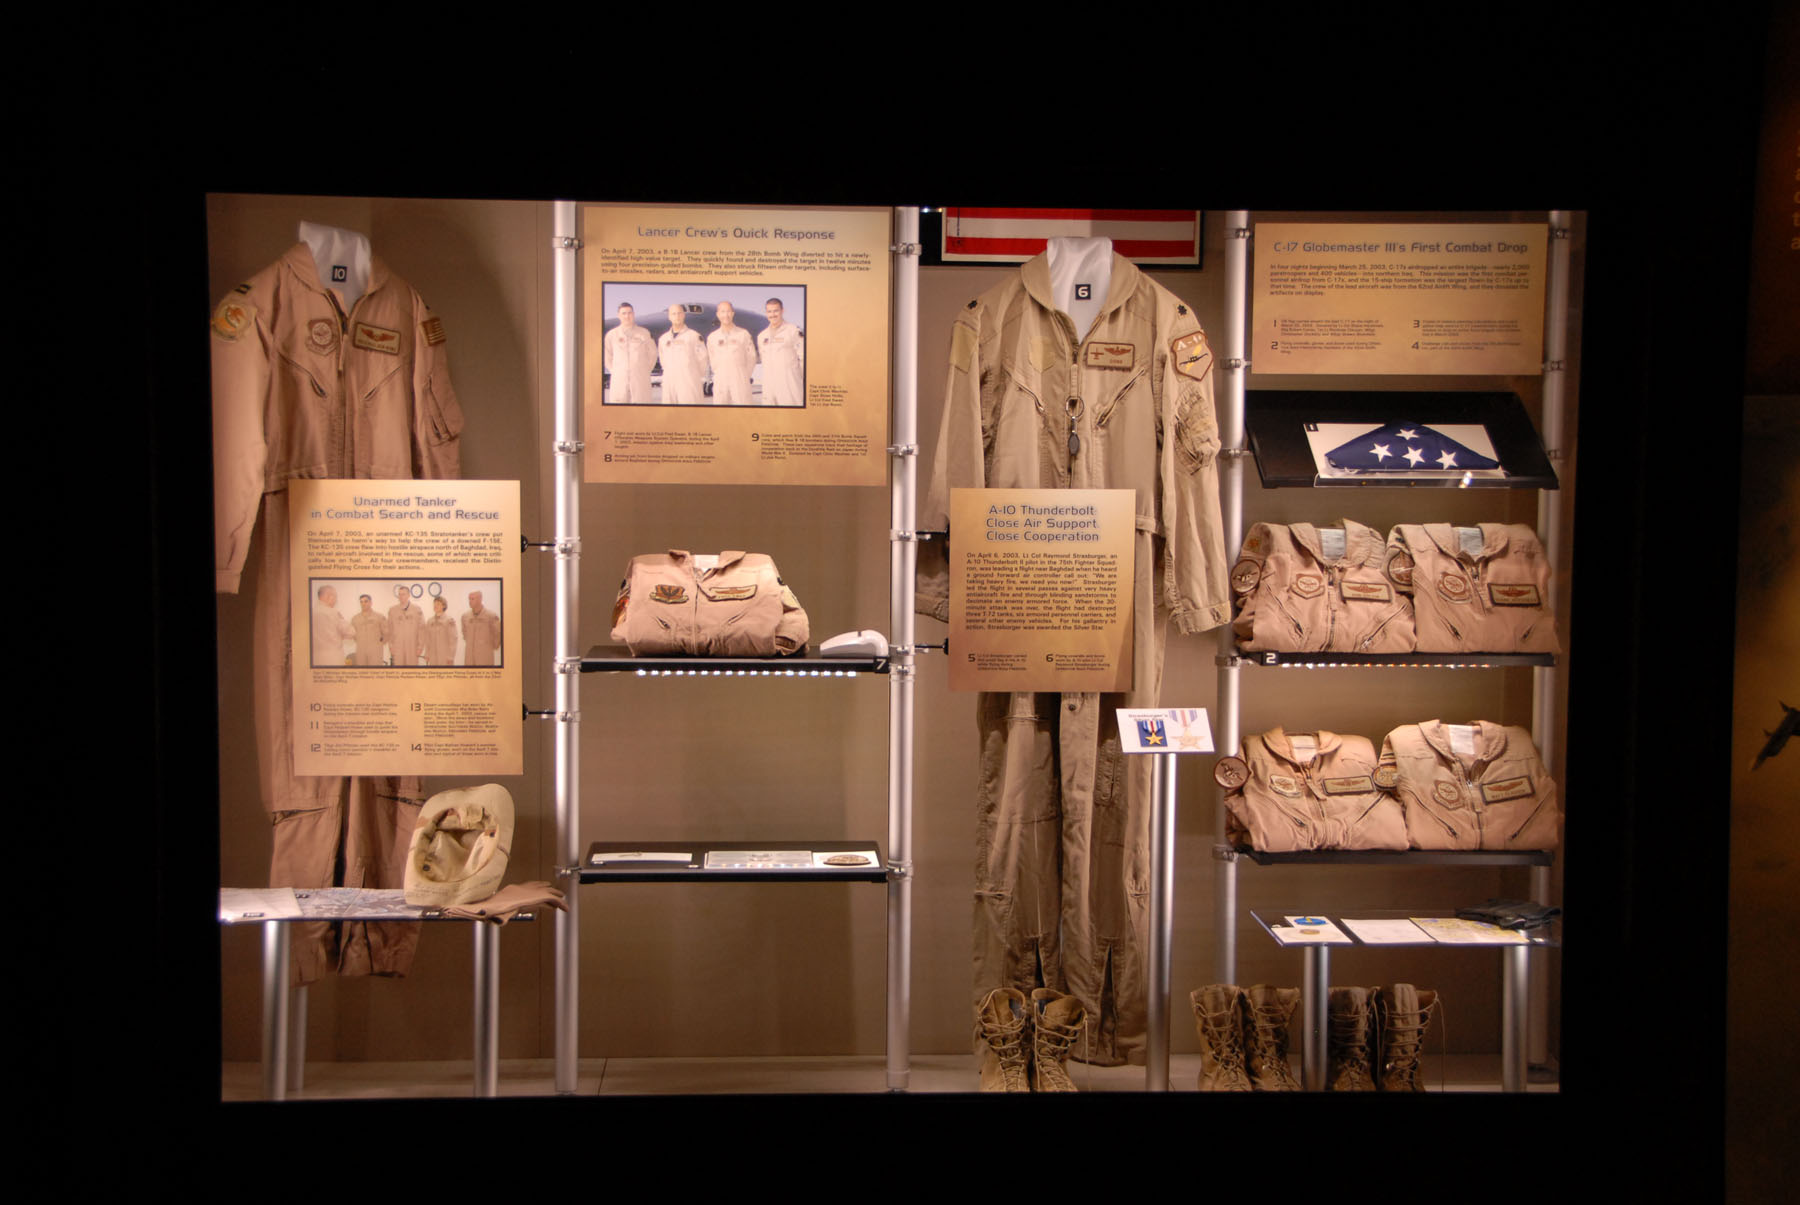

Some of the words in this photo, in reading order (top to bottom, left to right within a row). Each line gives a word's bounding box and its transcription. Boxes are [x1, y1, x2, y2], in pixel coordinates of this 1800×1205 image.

[638, 226, 680, 237] Lancer
[685, 226, 728, 238] Crew's
[733, 227, 768, 238] Quick
[774, 228, 835, 241] Response
[1273, 242, 1298, 253] C-17
[1303, 242, 1380, 252] Globemaster
[1385, 242, 1406, 252] III's
[1411, 242, 1441, 252] First
[1445, 241, 1494, 253] Combat
[1498, 242, 1528, 254] Drop
[334, 268, 346, 280] 10
[1078, 286, 1088, 298] 6
[1414, 320, 1420, 328] 3
[1271, 341, 1278, 350] 2
[1412, 342, 1419, 350] 4
[604, 431, 611, 440] 7
[752, 433, 759, 441] 9
[604, 454, 612, 462] 8
[353, 496, 410, 507] Unarmed
[415, 497, 456, 507] Tanker
[989, 505, 1015, 514] A-10
[310, 509, 321, 519] in
[325, 509, 374, 520] Combat
[379, 509, 423, 519] Search
[428, 510, 451, 519] and
[456, 510, 499, 519] Rescue
[986, 518, 1019, 528] Close
[1024, 518, 1041, 527] Air
[986, 531, 1019, 541] Close
[1024, 530, 1099, 543] Cooperation
[968, 654, 976, 662] 5
[1046, 654, 1053, 662] 6
[1266, 653, 1276, 663] 2
[876, 659, 887, 669] 7
[310, 703, 321, 712] 10
[411, 703, 421, 711] 13
[311, 744, 321, 752] 12
